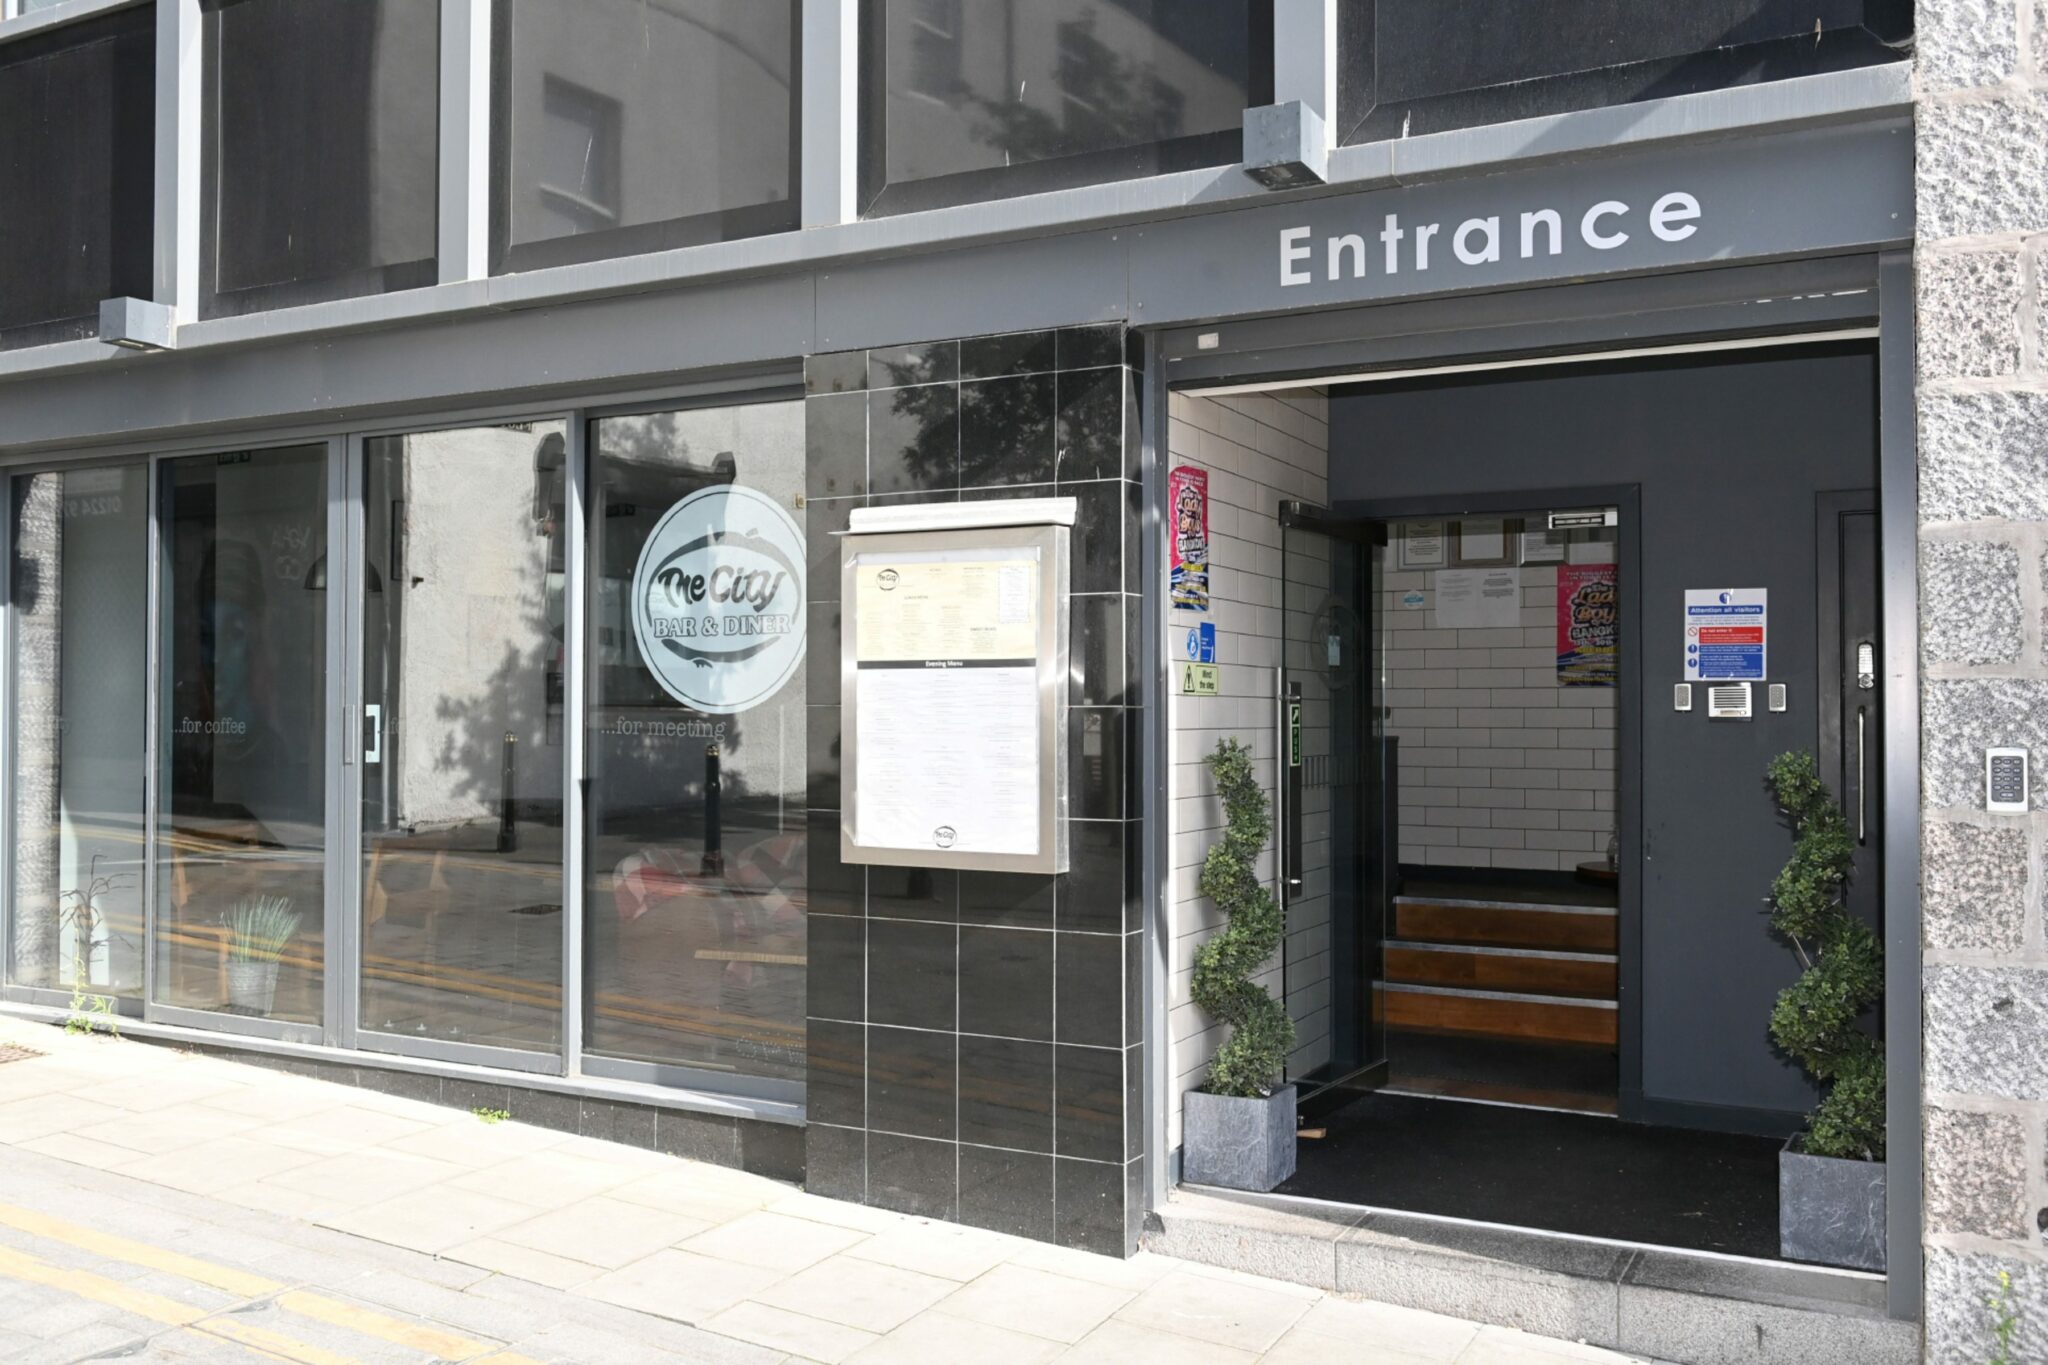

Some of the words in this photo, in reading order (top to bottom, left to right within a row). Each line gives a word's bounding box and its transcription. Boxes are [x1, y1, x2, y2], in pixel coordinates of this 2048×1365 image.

[1280, 191, 1701, 287] Entrance
[709, 565, 787, 613] City
[1573, 587, 1616, 606] Lad
[1575, 606, 1617, 625] Boy
[654, 617, 697, 638] BAR
[701, 615, 719, 637] &
[723, 613, 791, 636] DINER
[1572, 624, 1616, 640] BANGK
[925, 660, 947, 668] Evening
[1202, 669, 1213, 679] Mind
[1206, 681, 1215, 690] step
[171, 716, 202, 734] ...for
[204, 717, 246, 735] coffee
[600, 716, 642, 735] ...for
[647, 719, 727, 743] meeting
